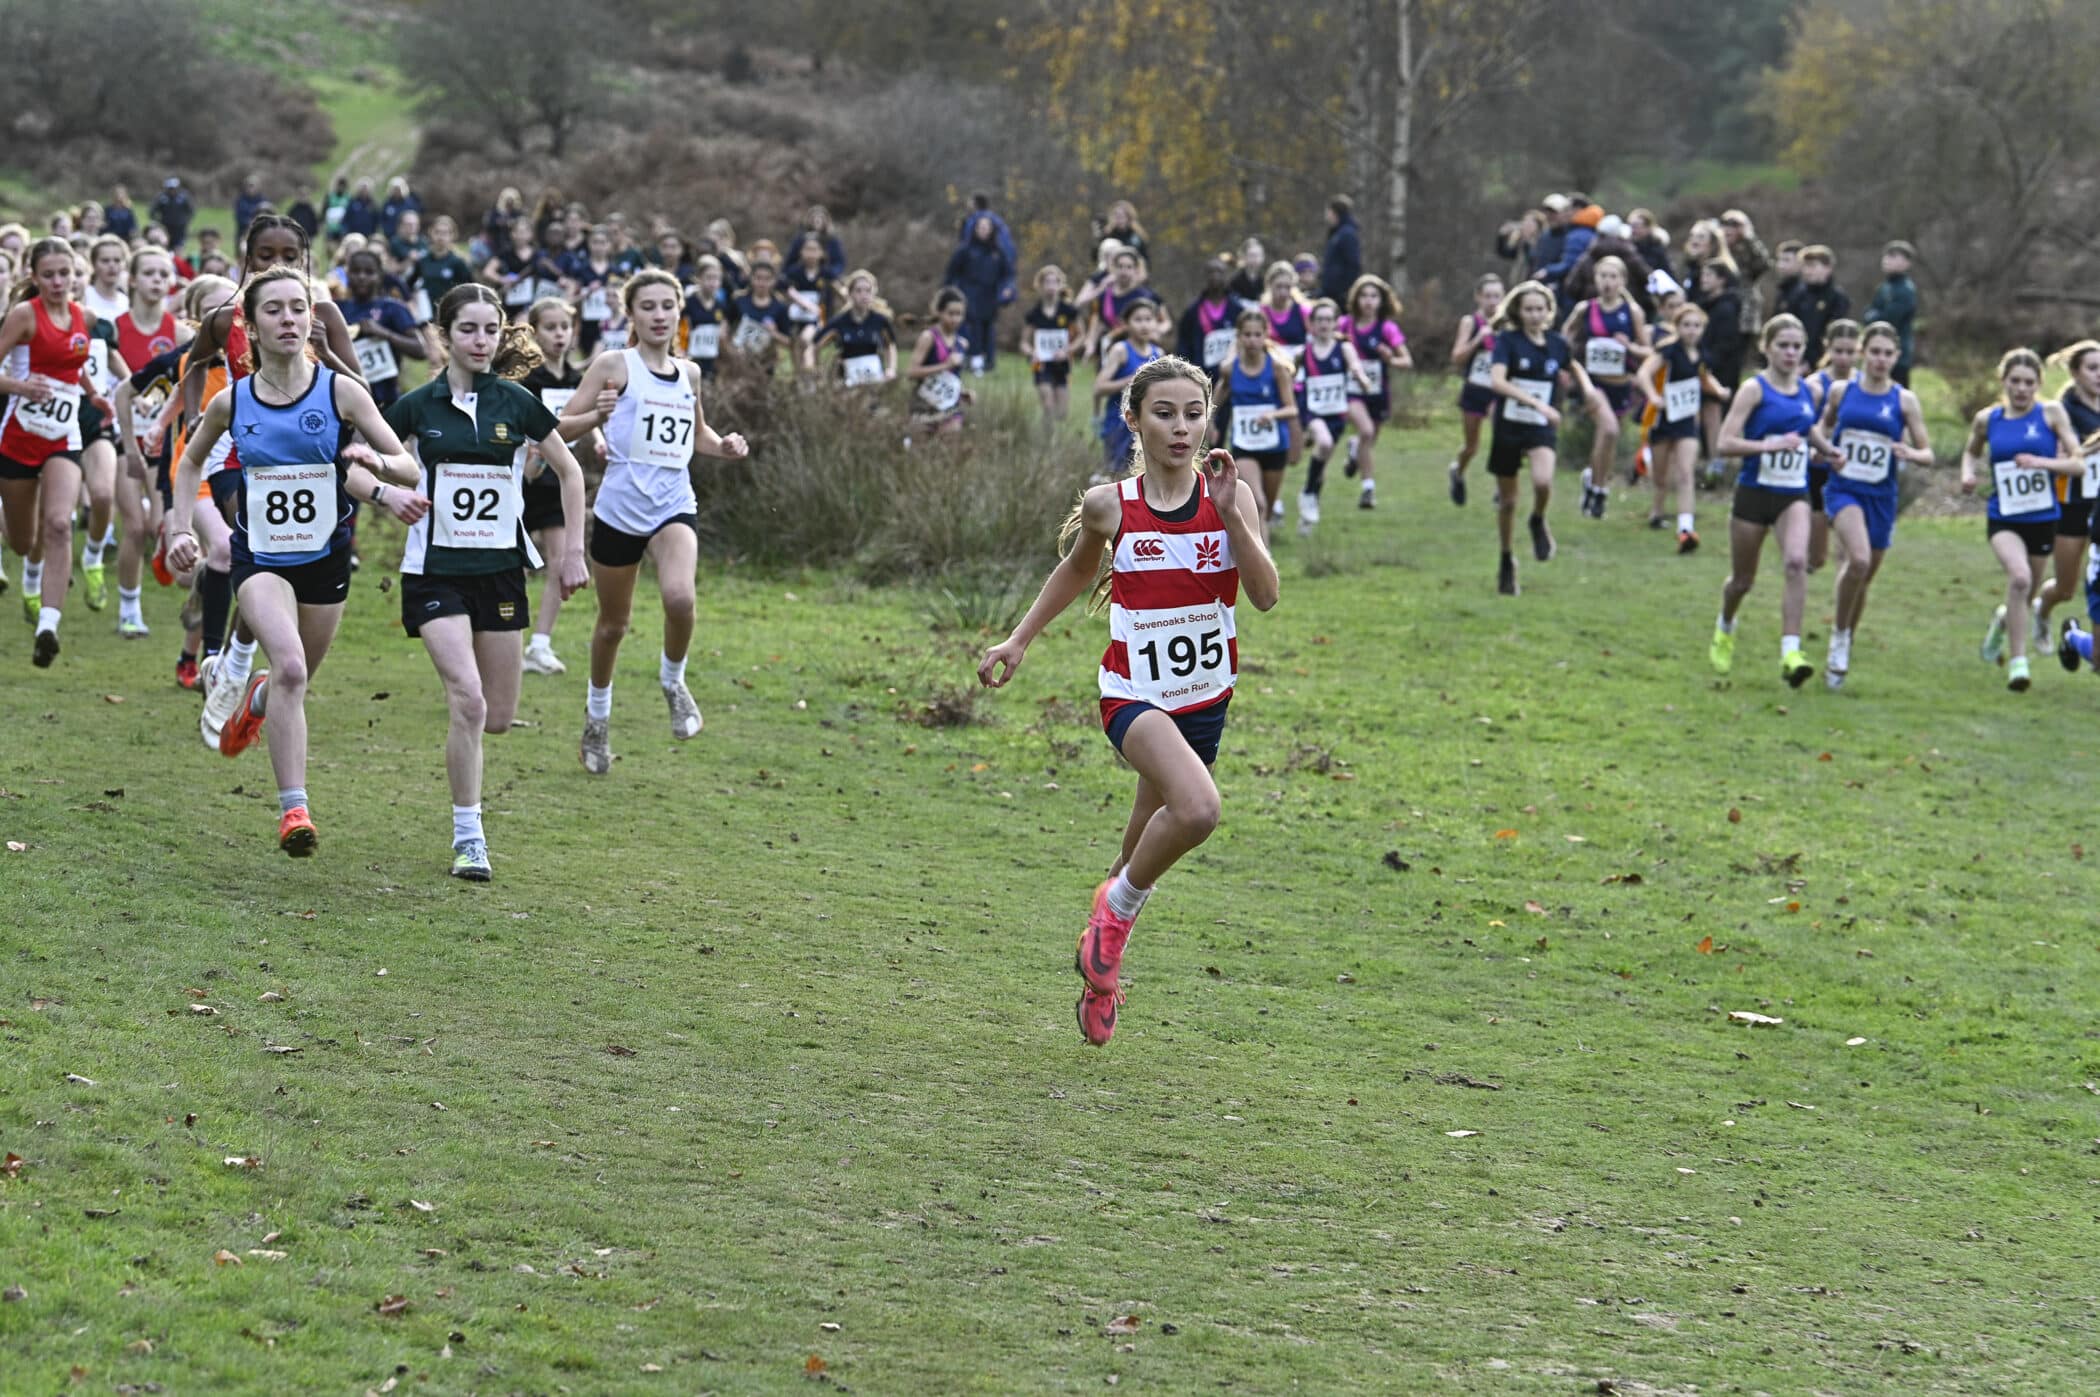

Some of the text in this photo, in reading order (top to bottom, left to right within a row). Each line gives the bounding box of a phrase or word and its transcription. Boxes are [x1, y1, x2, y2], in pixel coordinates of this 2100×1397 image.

[642, 413, 692, 446] 137
[1846, 443, 1886, 468] 102
[254, 471, 328, 481] Sevenoaks School
[443, 469, 485, 479] Sevenoaks
[2003, 472, 2046, 496] 106
[266, 488, 317, 526] 88
[452, 487, 499, 521] 92
[270, 533, 313, 542] Knole Run
[1133, 612, 1219, 631] Sevenoaks Schoo
[1138, 628, 1223, 681] 195
[1161, 682, 1210, 699] Knole Run
